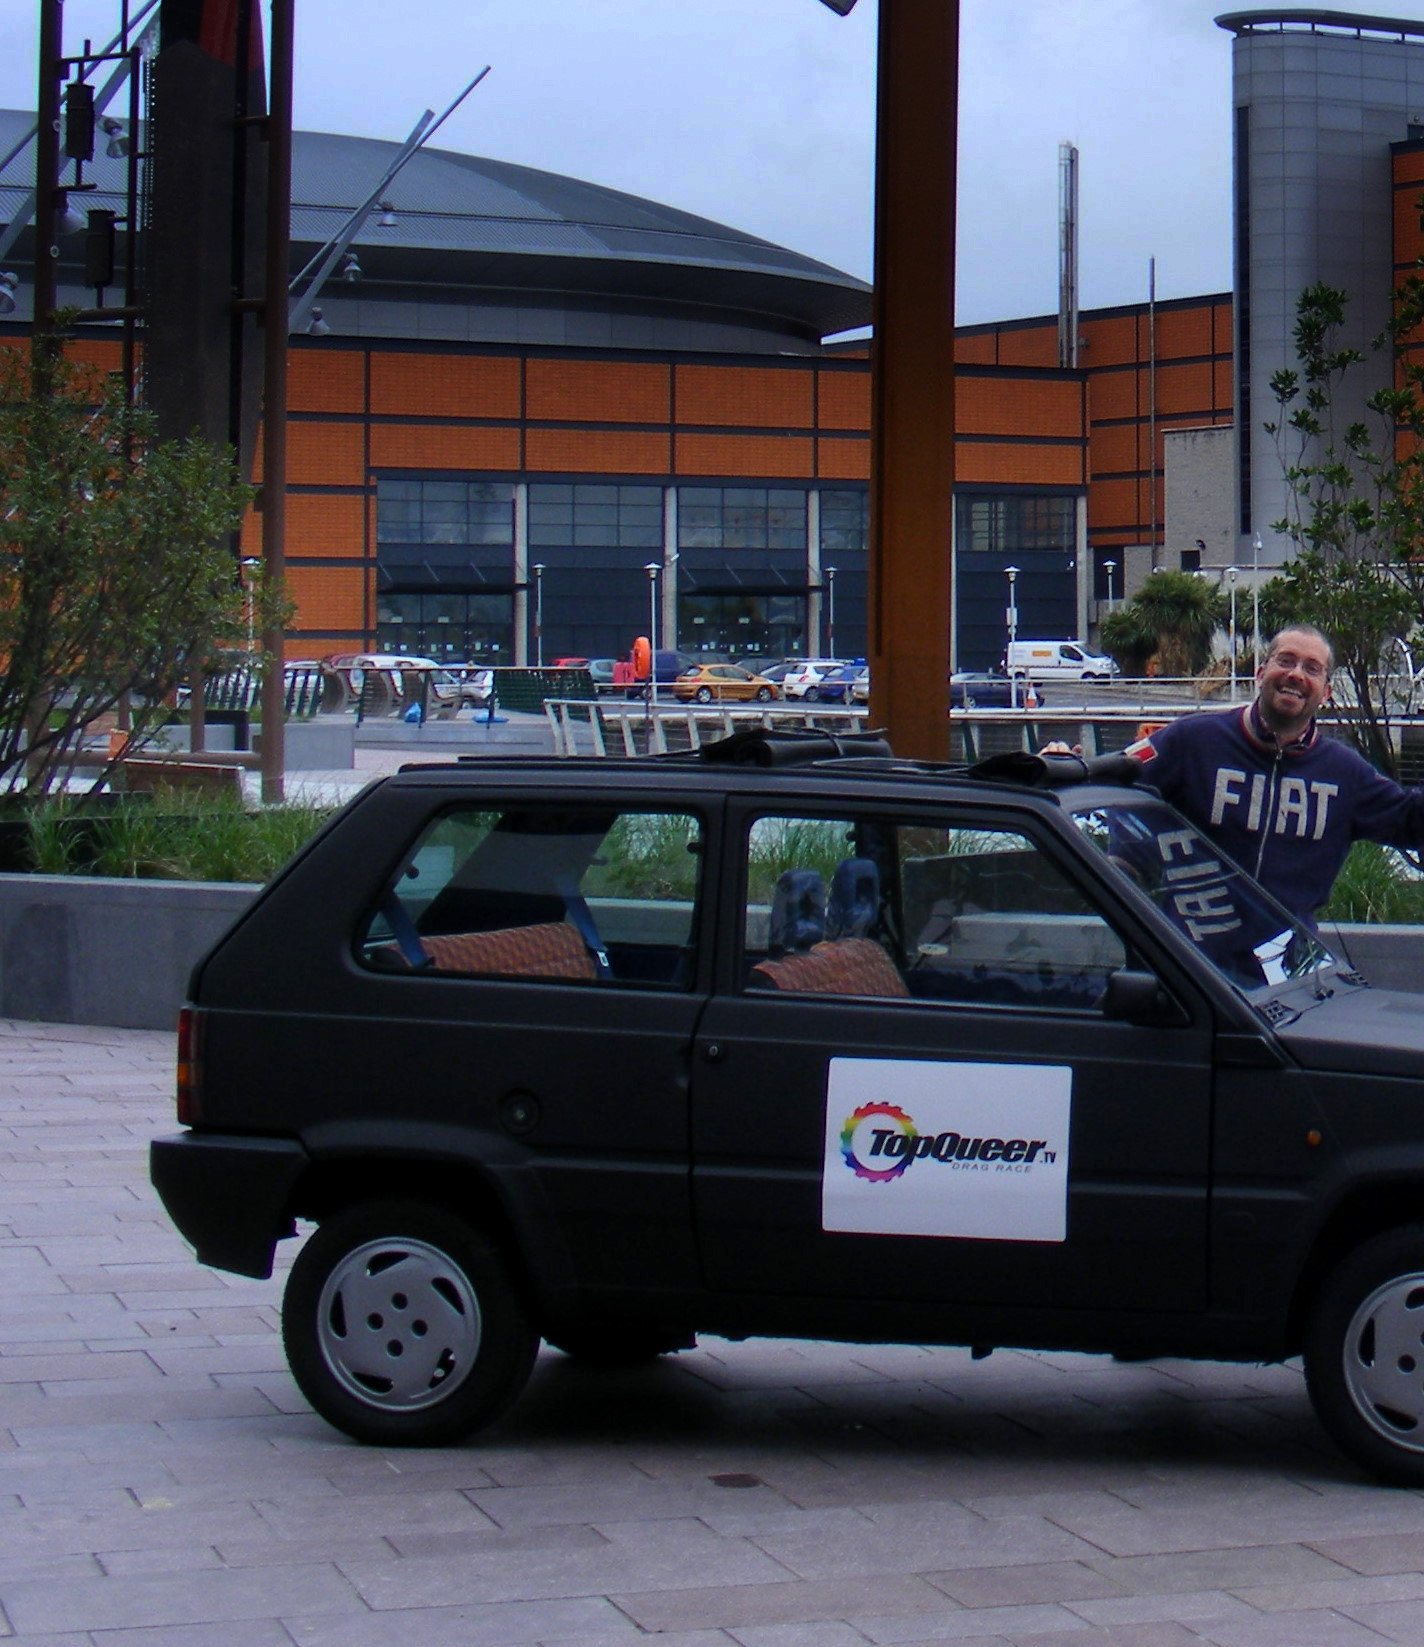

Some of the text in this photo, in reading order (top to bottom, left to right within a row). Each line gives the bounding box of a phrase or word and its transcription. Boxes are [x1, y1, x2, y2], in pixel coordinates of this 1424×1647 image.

[1210, 768, 1339, 840] FIAT
[952, 1162, 1032, 1173] DRAG RACE
